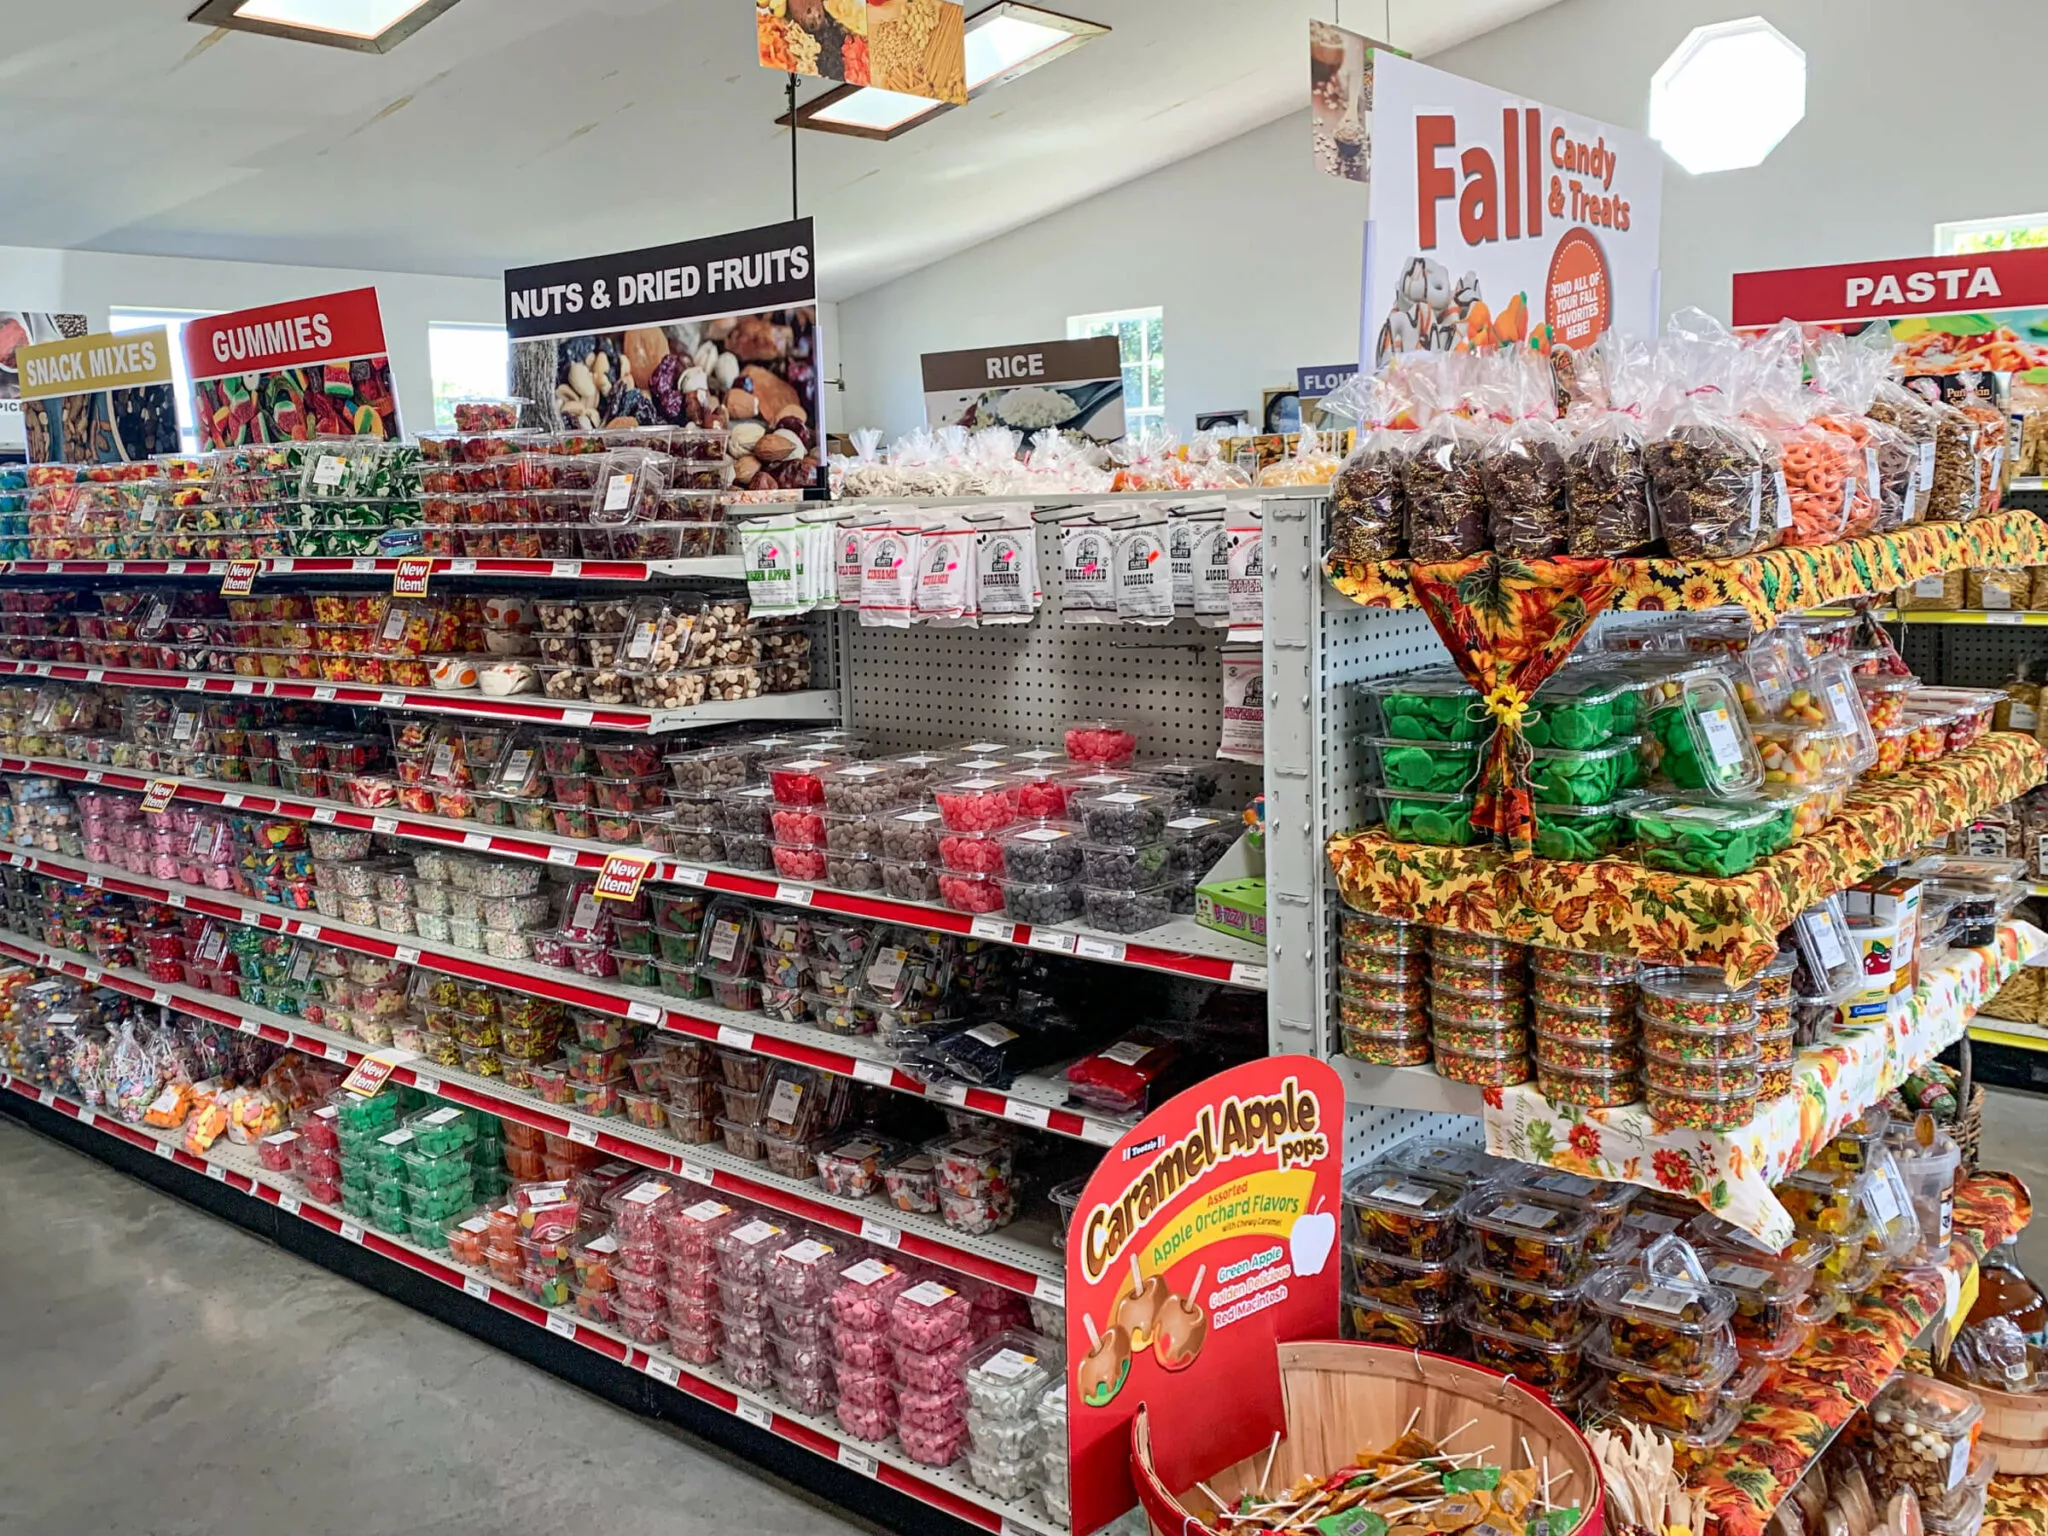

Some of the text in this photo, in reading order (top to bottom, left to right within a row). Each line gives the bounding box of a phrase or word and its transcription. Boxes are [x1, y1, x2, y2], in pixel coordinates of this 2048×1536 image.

[1550, 126, 1617, 191] Candy
[1416, 108, 1542, 251] Fall
[1548, 175, 1630, 231] & Treats
[511, 245, 810, 320] NUTS & DRIED FRUITS
[1552, 271, 1600, 299] FIND ALL OF
[1846, 266, 2002, 308] PASTA
[1556, 287, 1599, 313] YOUR FALL
[1557, 302, 1599, 329] FAVORITES
[212, 313, 332, 362] GUMMIES
[1566, 319, 1591, 341] HERE!
[26, 341, 157, 387] SNACK MIXES
[986, 352, 1045, 380] RICE
[1303, 372, 1351, 390] FLOU
[225, 577, 250, 590] Item!
[230, 564, 252, 577] New
[400, 562, 427, 577] New
[396, 577, 426, 592] Item!
[144, 796, 169, 809] Item!
[151, 783, 173, 797] New
[606, 859, 641, 878] New
[599, 874, 637, 895] Item!
[350, 1071, 382, 1092] Item!
[359, 1060, 388, 1078] New
[1281, 1136, 1326, 1167] pops
[1085, 1082, 1315, 1278] Caramel Apple
[1207, 1180, 1248, 1208] Assorted
[1153, 1194, 1299, 1266] Apple Orchard Flavors
[1218, 1247, 1282, 1281] Green Apple
[1210, 1266, 1290, 1307] Golden Delicious
[1215, 1287, 1286, 1327] Red Macintosh
